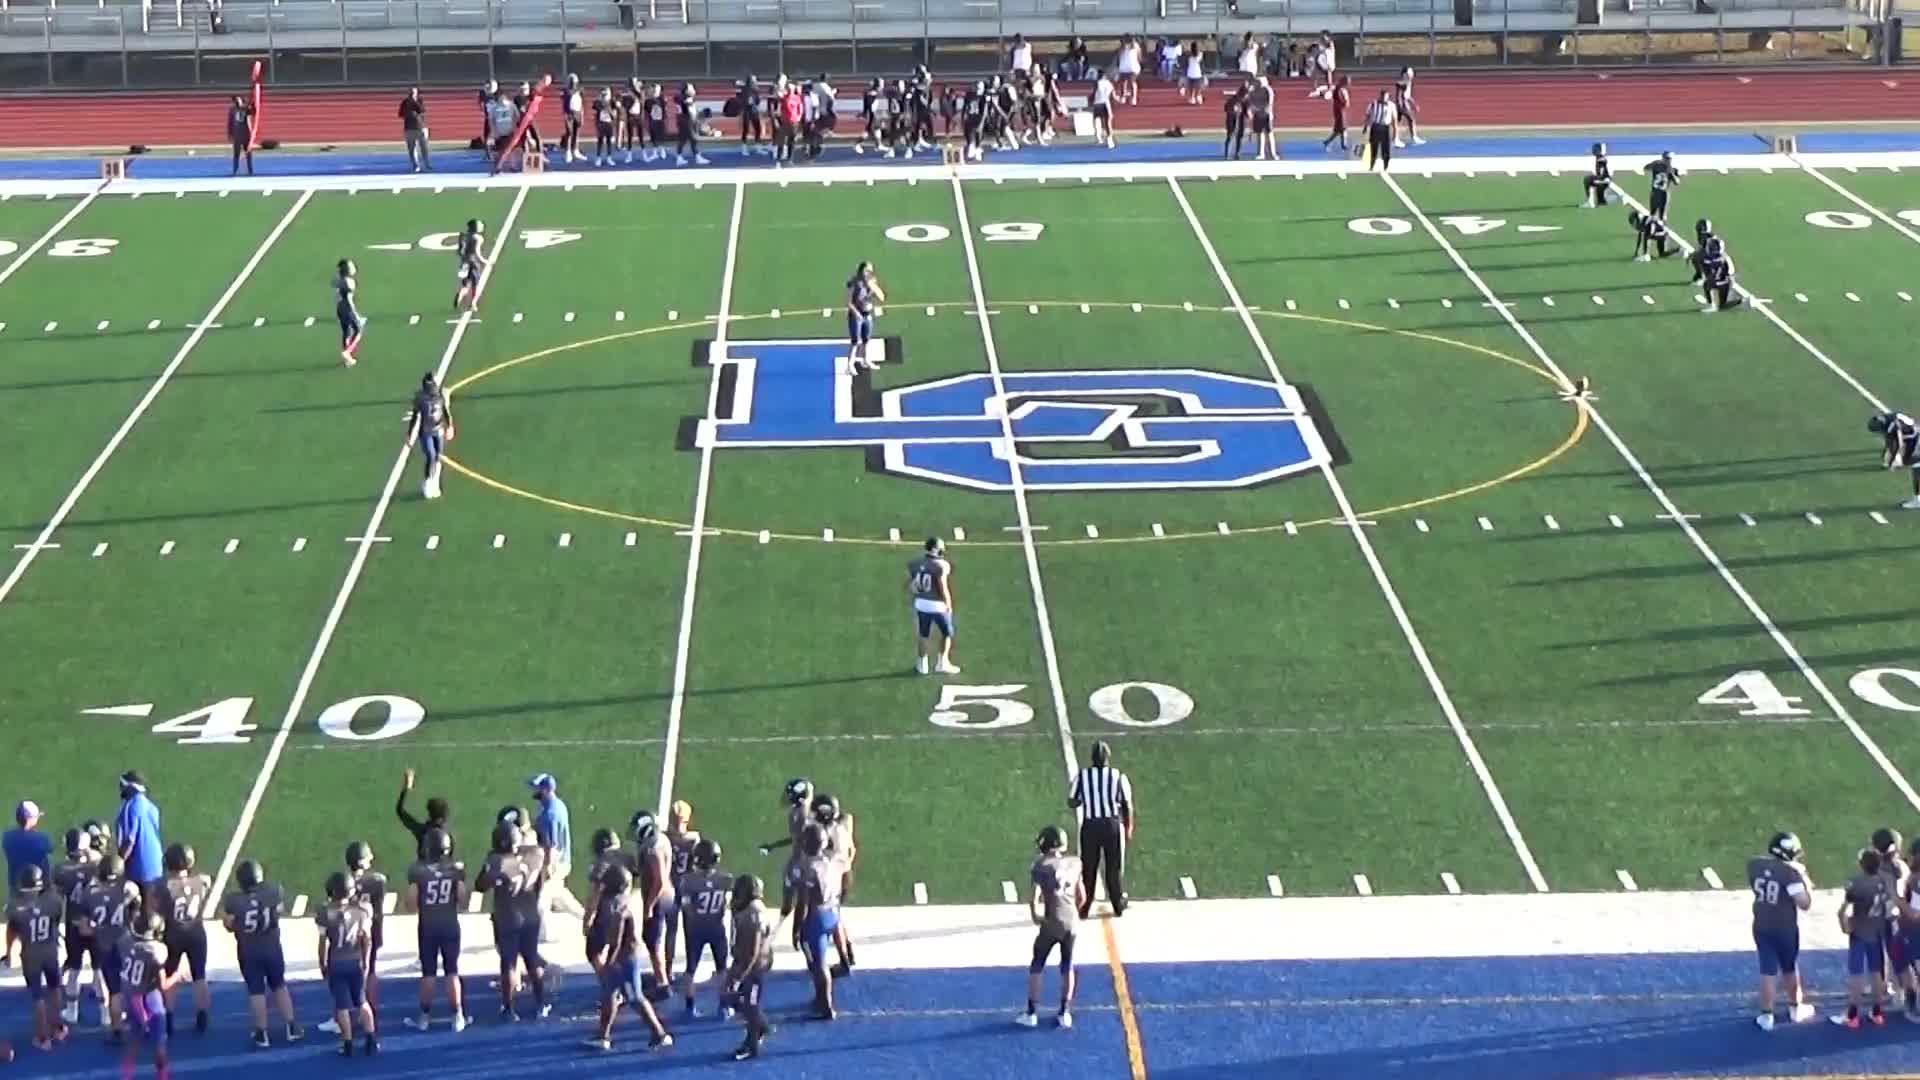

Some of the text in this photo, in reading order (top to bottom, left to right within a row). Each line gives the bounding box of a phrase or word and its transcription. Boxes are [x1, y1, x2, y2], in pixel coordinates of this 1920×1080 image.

[426, 879, 452, 904] 59
[697, 890, 722, 915] 30
[1754, 877, 1780, 905] 58
[29, 915, 51, 943] 19
[244, 906, 271, 934] 51
